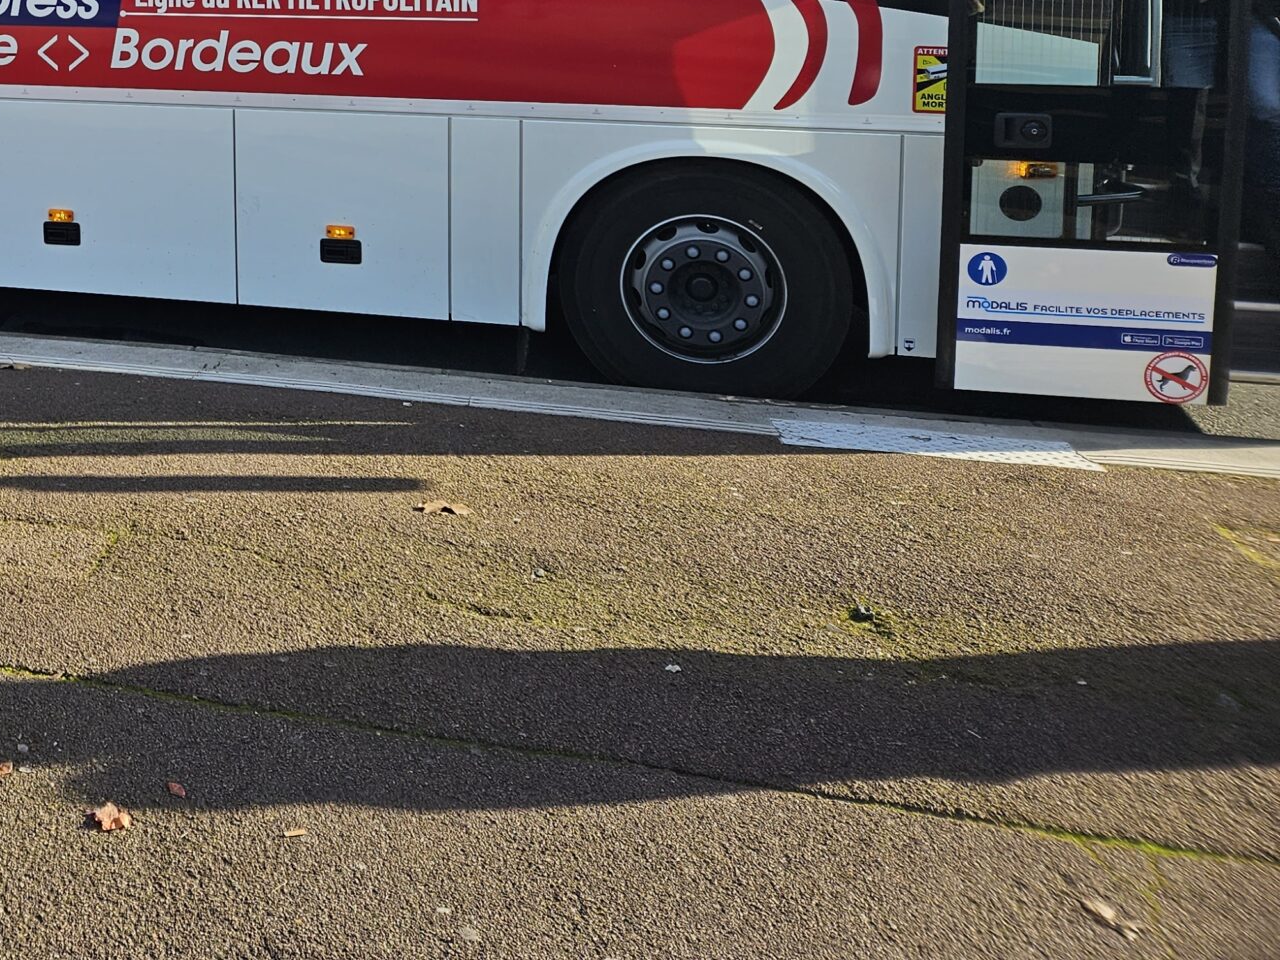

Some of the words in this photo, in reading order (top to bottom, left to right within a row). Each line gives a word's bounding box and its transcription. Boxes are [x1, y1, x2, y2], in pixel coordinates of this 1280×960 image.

[110, 27, 368, 76] Bordeaux
[966, 299, 1028, 311] MODALIS
[1033, 304, 1083, 314] FACILITE
[1086, 307, 1108, 316] VOS
[1110, 308, 1206, 321] DEPLACEMENTS
[964, 326, 1011, 335] modalis.fr
